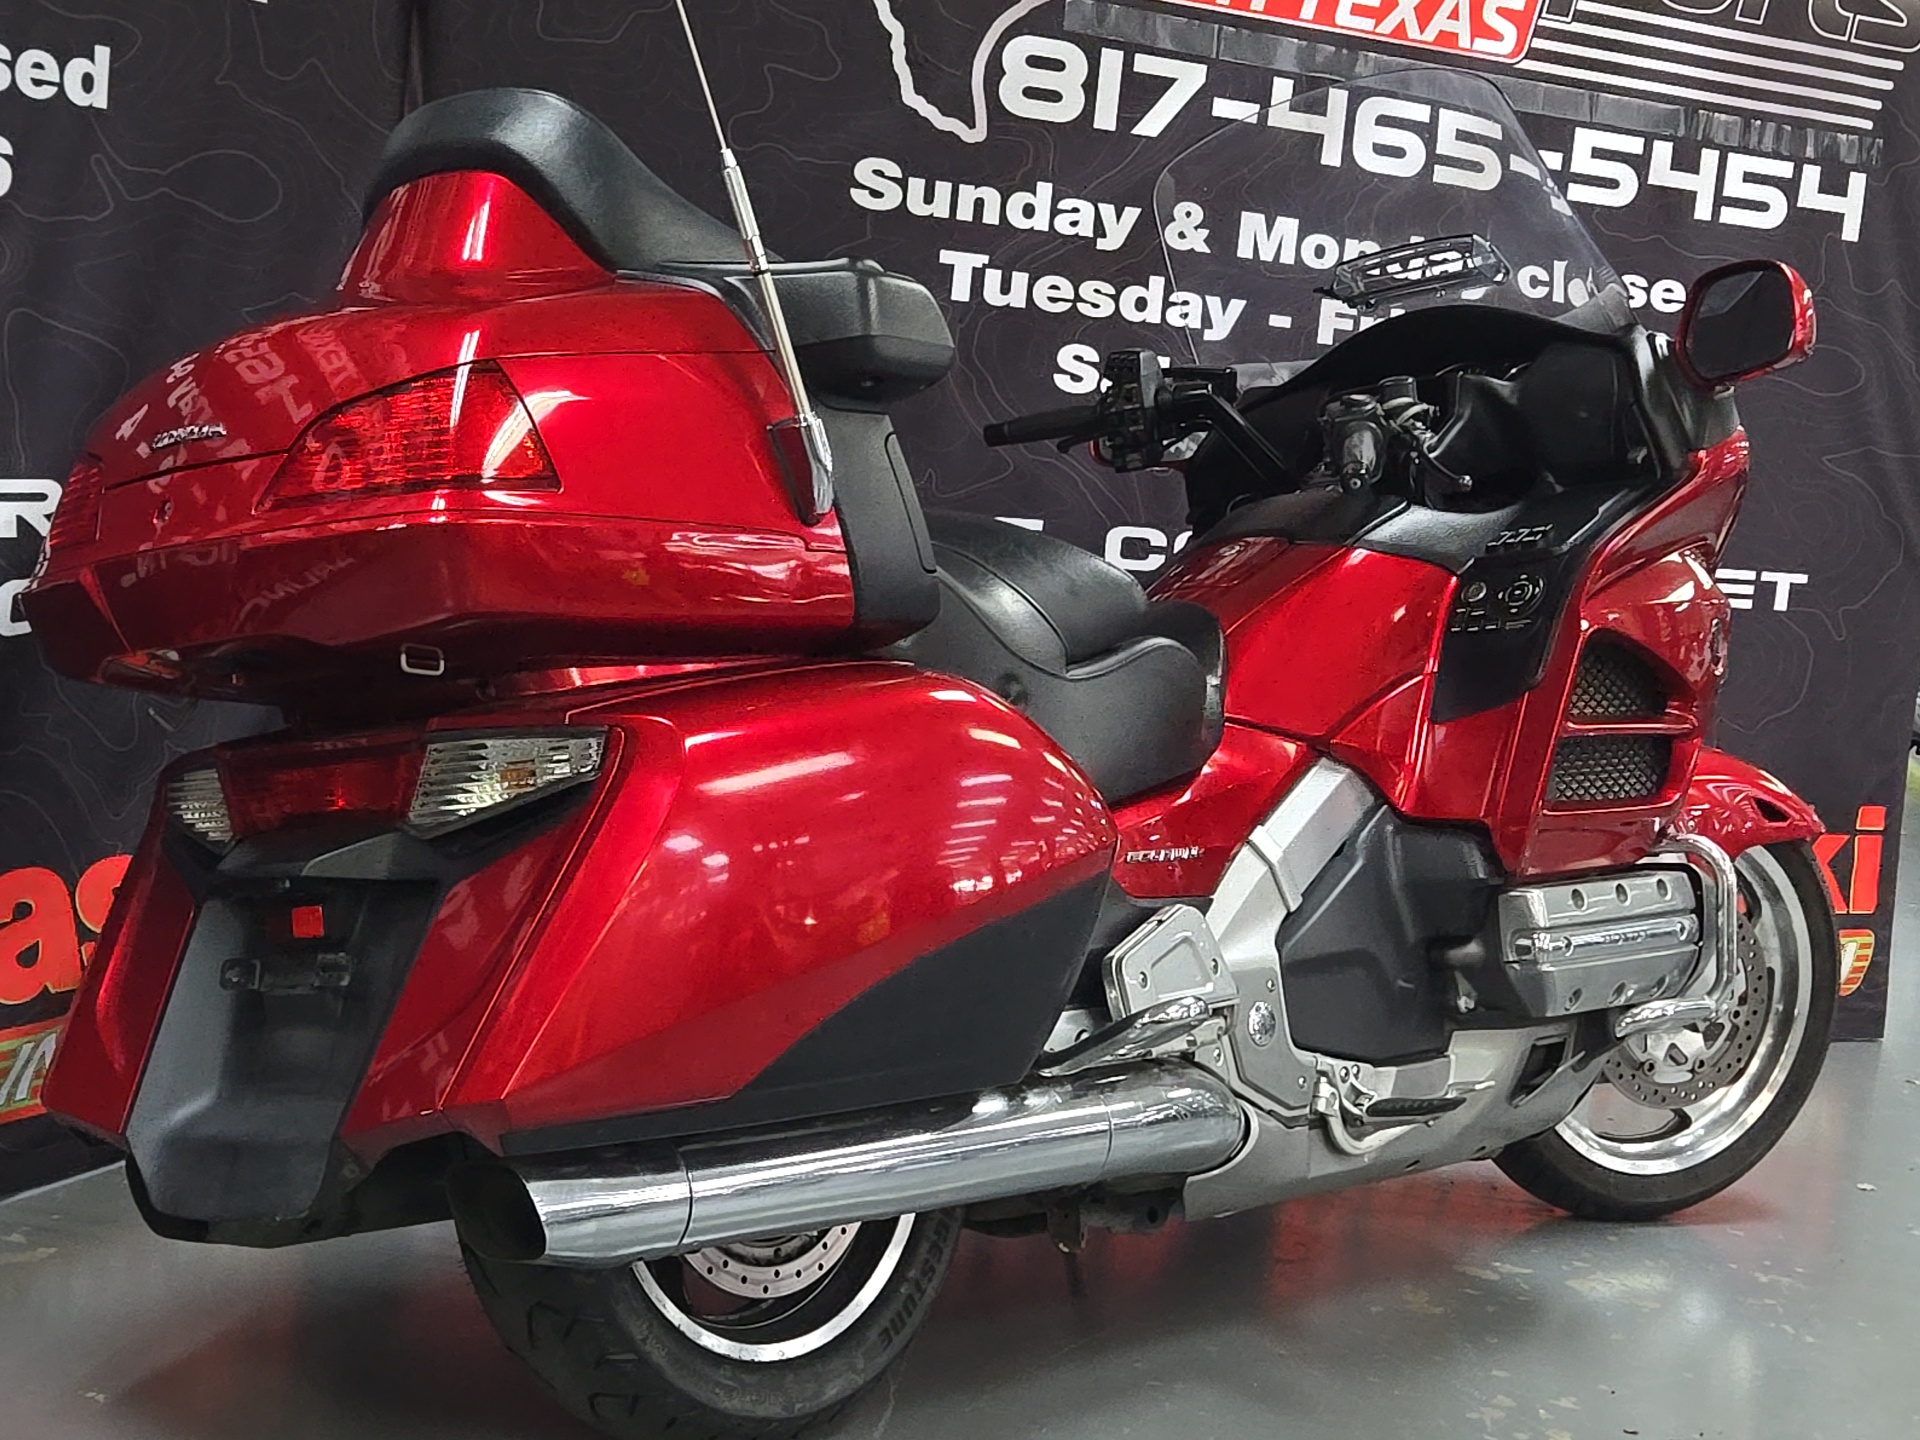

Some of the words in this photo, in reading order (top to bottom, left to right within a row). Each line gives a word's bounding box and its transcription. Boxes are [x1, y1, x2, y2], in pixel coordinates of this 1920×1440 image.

[999, 34, 1867, 242] 817-465-5454
[849, 157, 1142, 251] Sunday
[1164, 201, 1211, 254] &
[938, 249, 1248, 341] Tuesday
